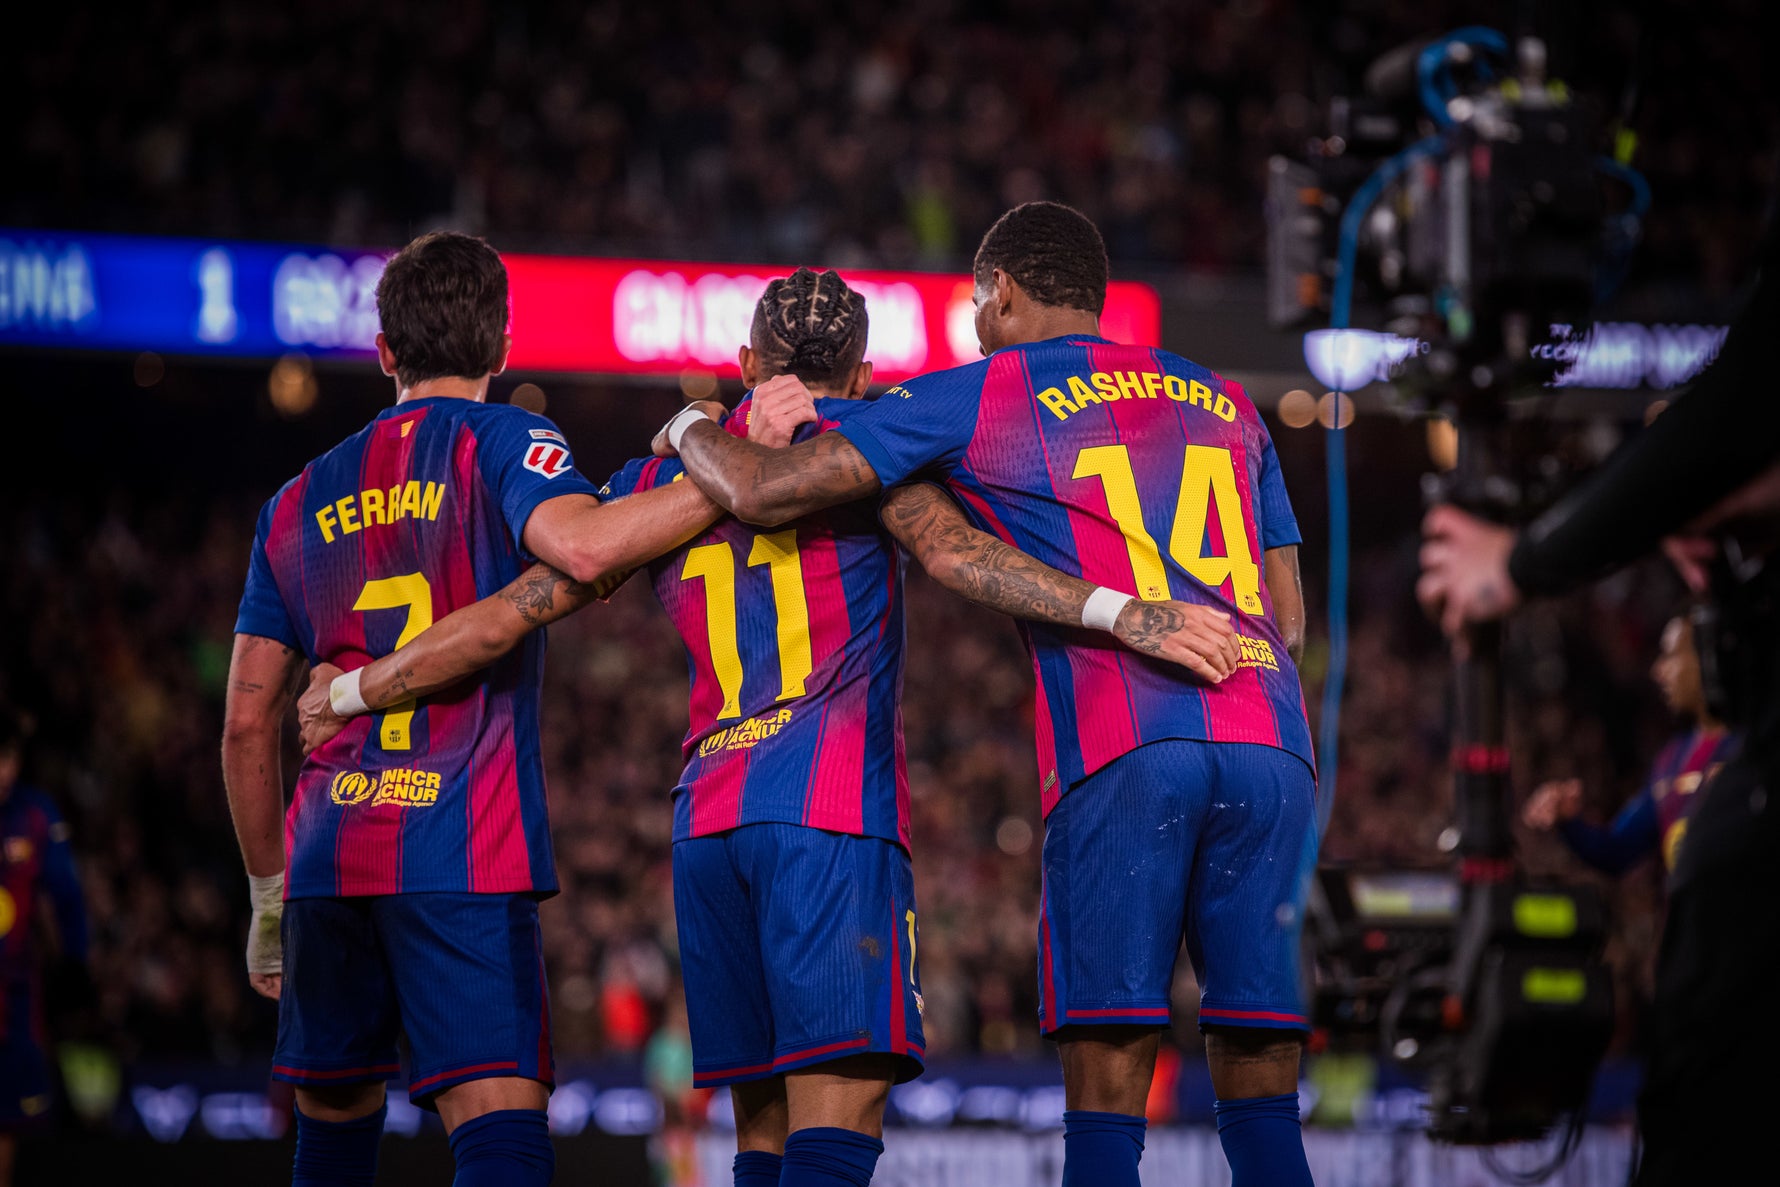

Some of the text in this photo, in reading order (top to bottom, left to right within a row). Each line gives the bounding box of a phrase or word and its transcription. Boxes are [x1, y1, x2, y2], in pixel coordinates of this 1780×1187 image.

[1036, 371, 1238, 423] RASHFORD
[315, 480, 446, 544] FERRAN
[1071, 444, 1265, 616] 14
[680, 528, 814, 721] 11
[1235, 633, 1273, 653] HCR
[1240, 645, 1278, 666] NUR
[352, 571, 433, 751] 7
